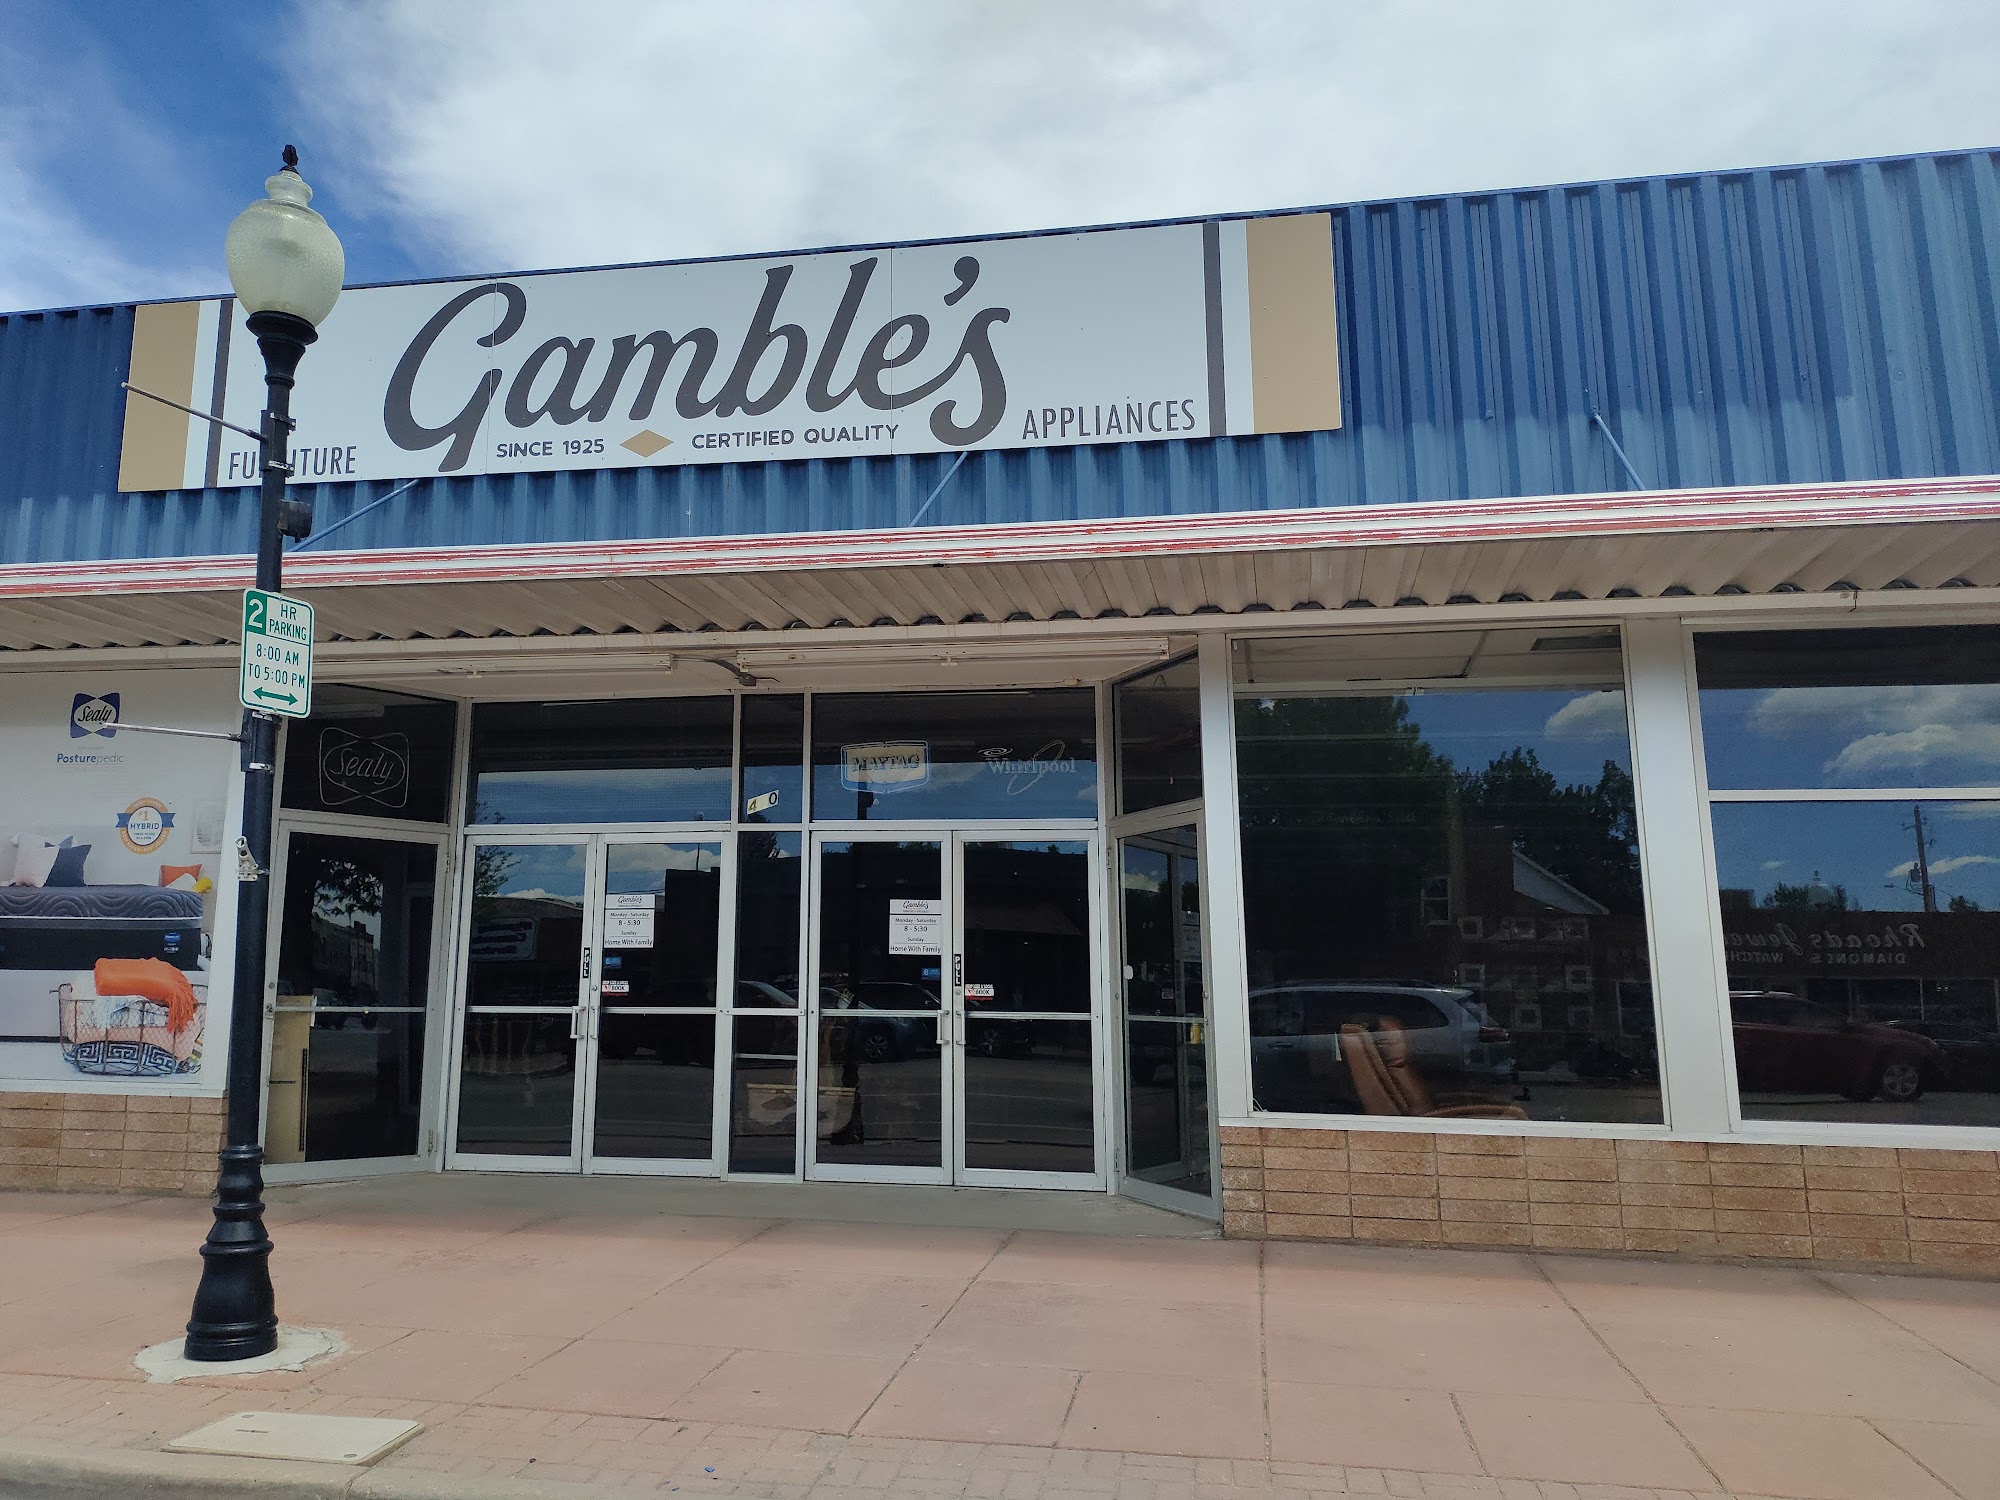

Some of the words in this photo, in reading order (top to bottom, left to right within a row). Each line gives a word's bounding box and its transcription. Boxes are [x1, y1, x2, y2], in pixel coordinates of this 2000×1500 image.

[383, 256, 1011, 474] Gamble's
[1022, 399, 1196, 440] APPLIANCES
[496, 441, 554, 458] SINCE
[563, 438, 605, 456] 1925
[691, 429, 795, 450] CERTIFIED
[803, 424, 900, 444] QUALITY
[228, 445, 357, 480] FUITURE
[248, 598, 264, 629] 2
[280, 603, 297, 621] HR
[269, 618, 307, 641] PARKING
[256, 643, 281, 662] 8:00
[284, 650, 300, 667] AM
[248, 662, 261, 679] TO
[264, 666, 288, 685] 5:00
[291, 672, 306, 689] PM
[77, 705, 113, 725] Sealy
[56, 751, 124, 766] Posturepedic
[329, 748, 395, 785] Sealy
[985, 757, 1077, 776] Whirlpool
[130, 822, 160, 830] HYBRID
[922, 946, 941, 954] Family
